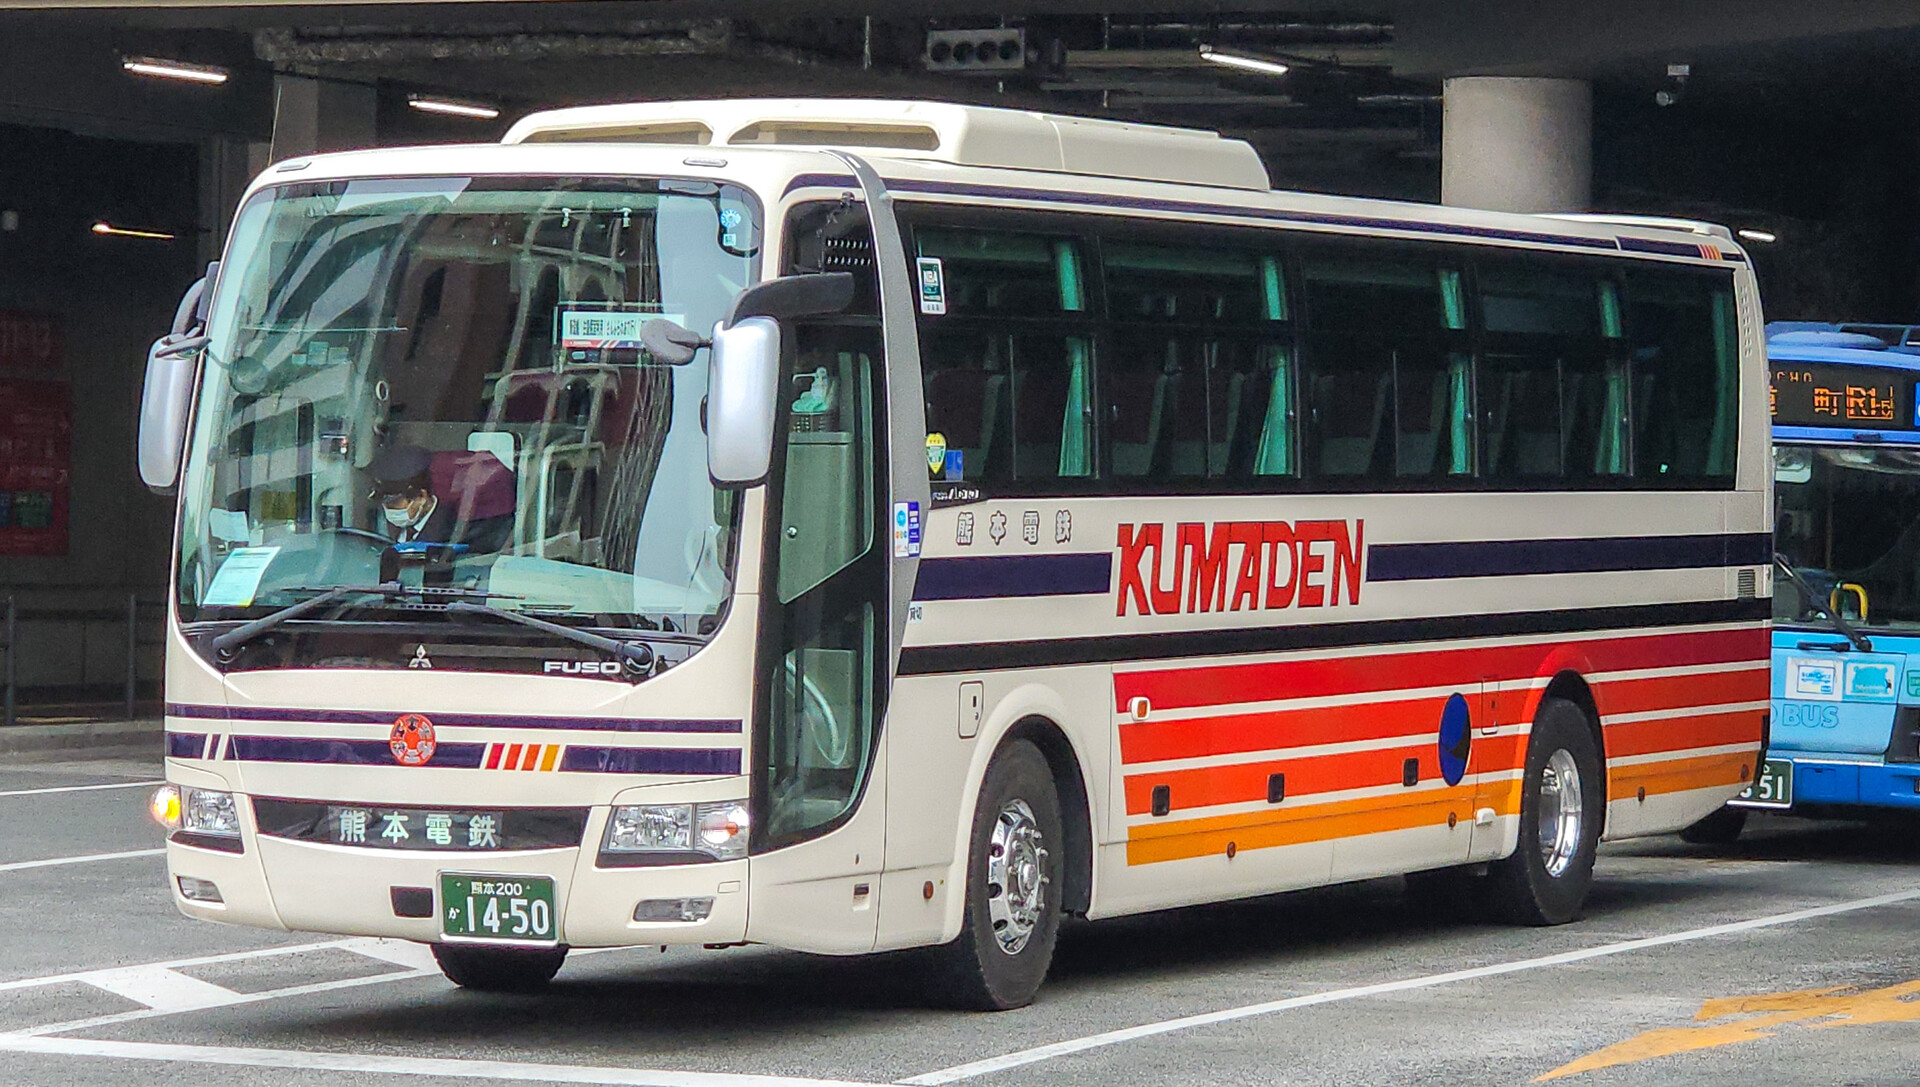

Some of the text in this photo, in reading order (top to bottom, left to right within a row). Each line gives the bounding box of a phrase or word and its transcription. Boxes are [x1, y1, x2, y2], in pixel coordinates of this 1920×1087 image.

[956, 510, 1072, 546] 熊本電鉄
[1116, 519, 1364, 617] KUMADEN
[543, 660, 621, 674] FUSO
[1782, 703, 1840, 729] BUS
[339, 809, 497, 848] 熊本電鉄
[466, 896, 550, 936] 14-50
